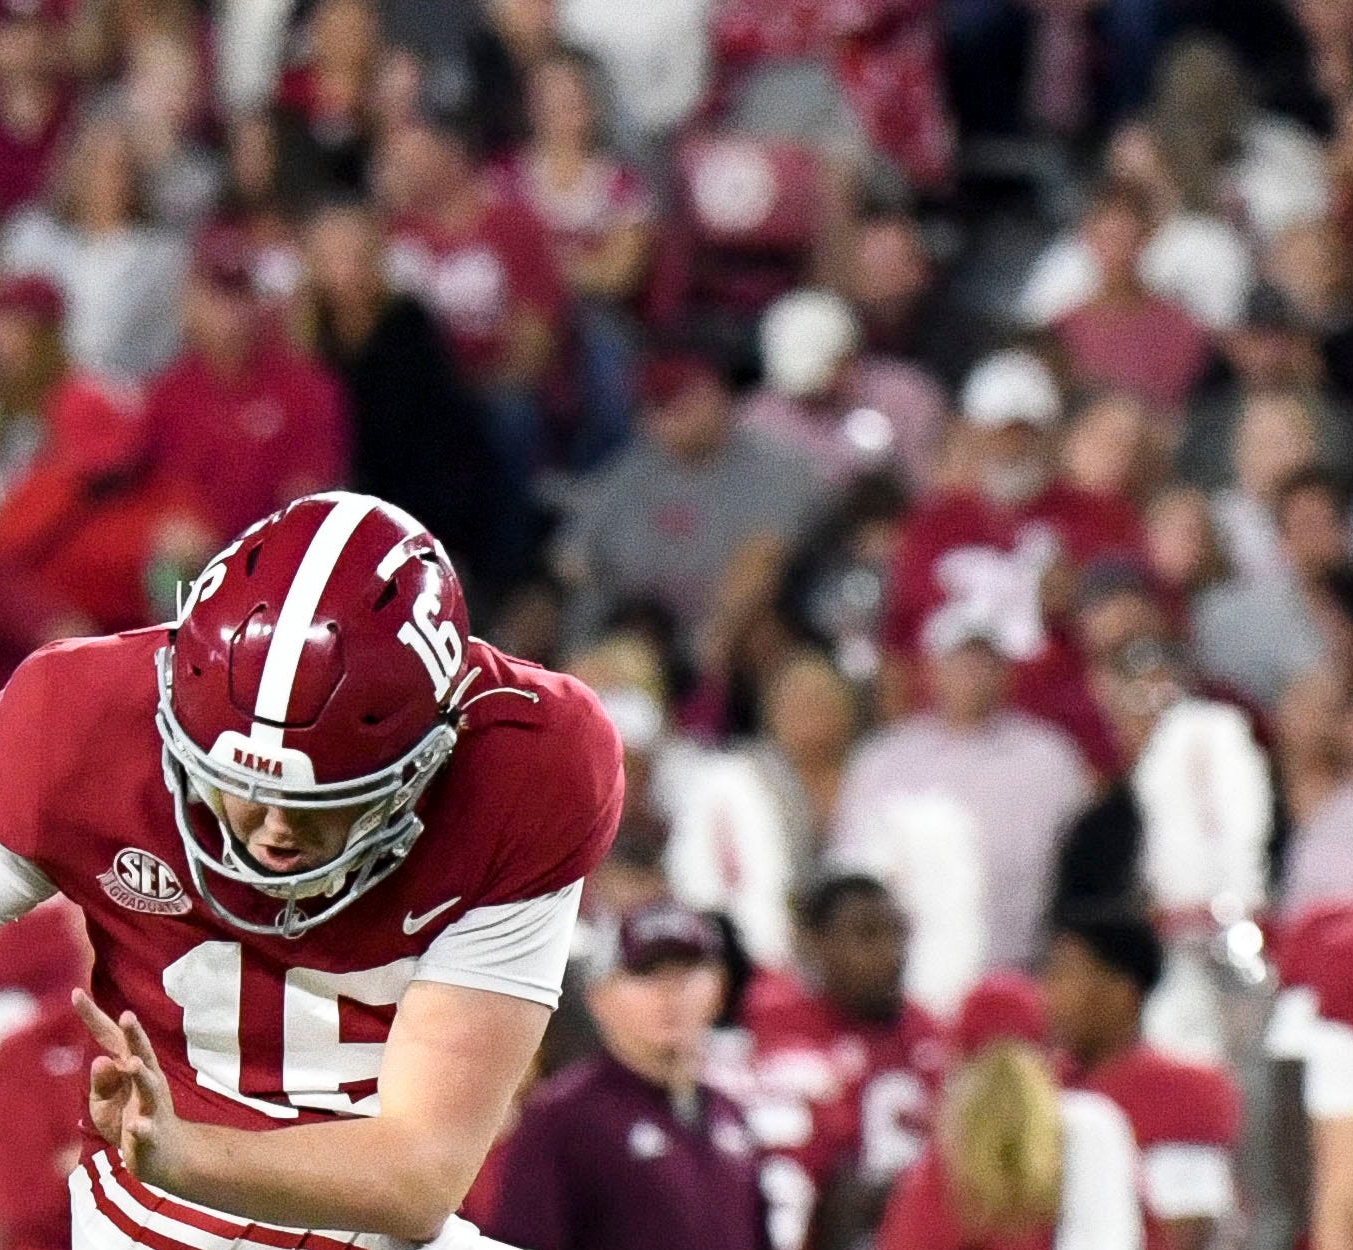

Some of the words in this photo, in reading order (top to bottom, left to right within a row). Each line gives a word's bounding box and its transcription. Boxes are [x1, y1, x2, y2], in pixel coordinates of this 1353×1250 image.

[397, 590, 463, 704] 16
[233, 747, 283, 778] BAMA
[120, 852, 176, 899] SEC
[109, 885, 183, 913] GRADUATE
